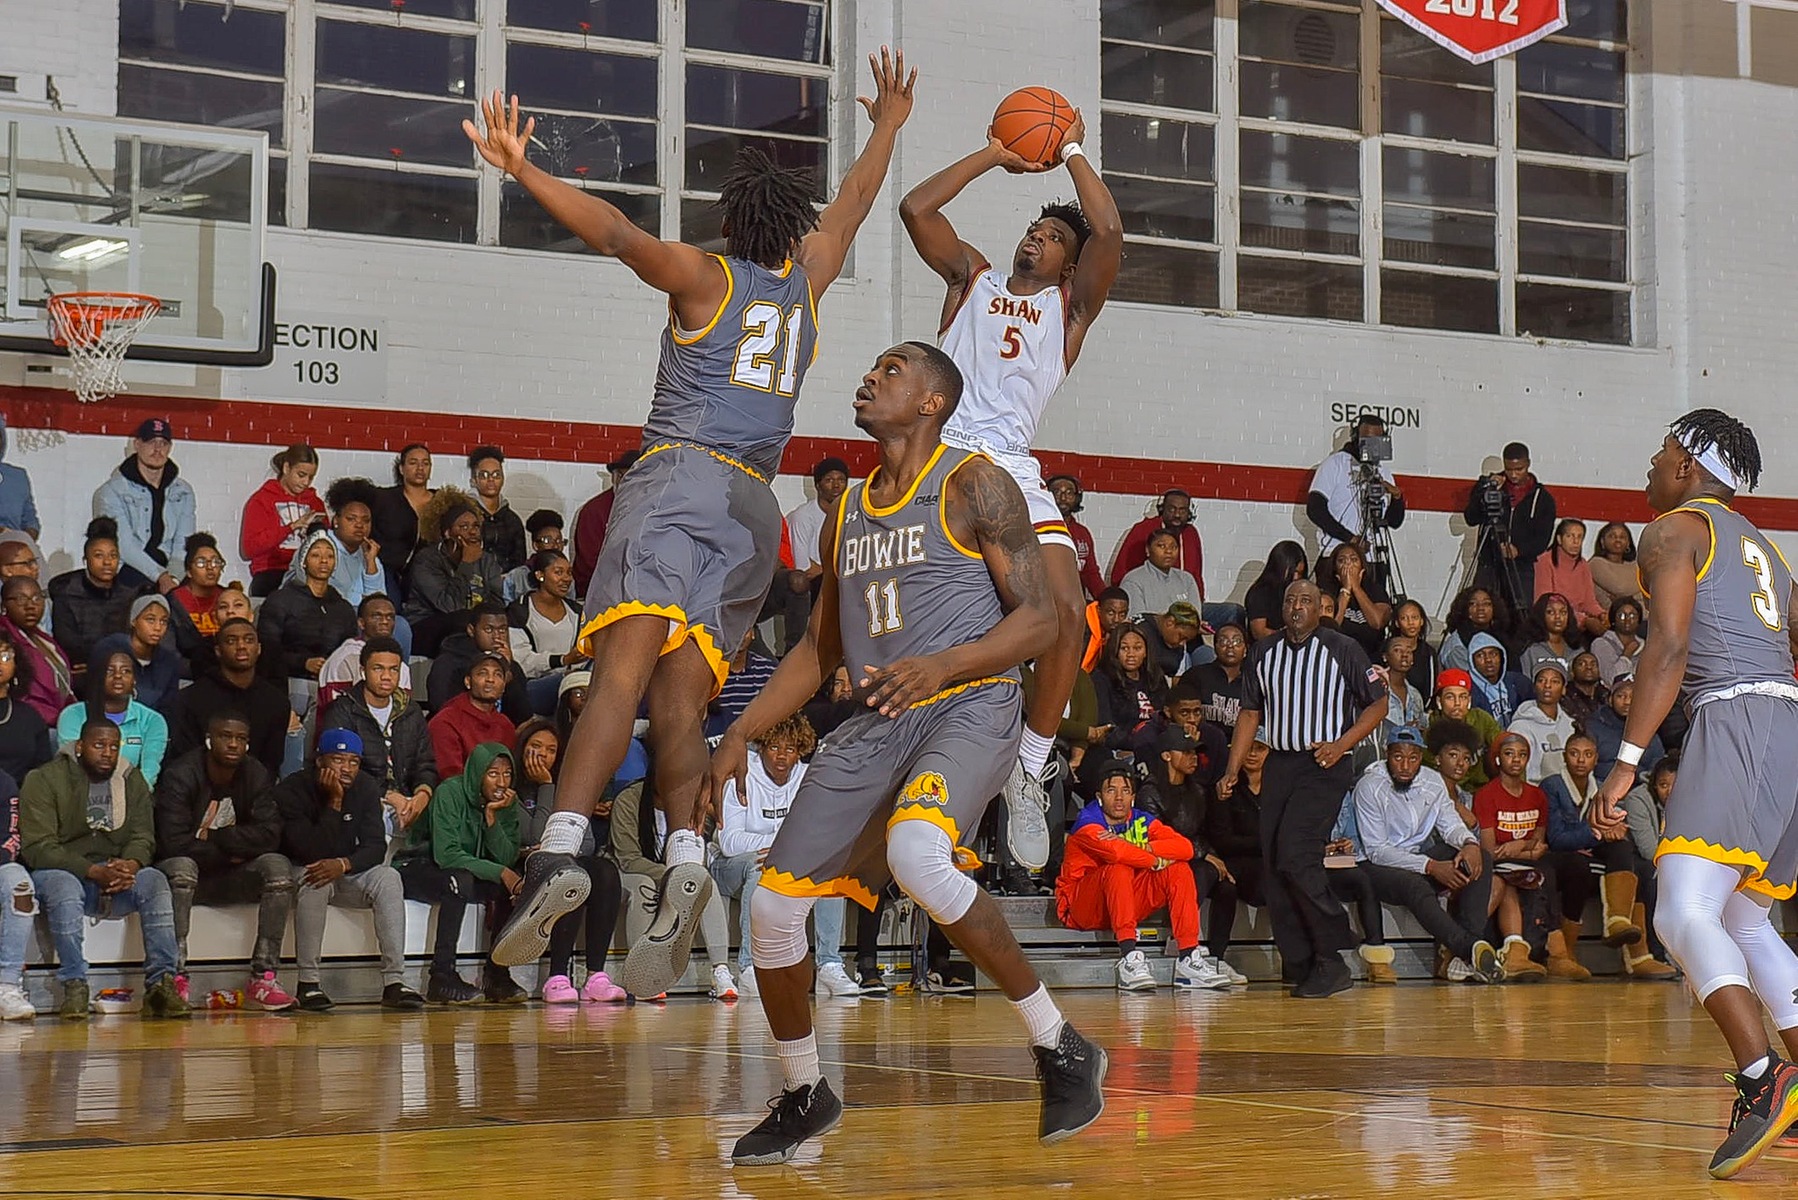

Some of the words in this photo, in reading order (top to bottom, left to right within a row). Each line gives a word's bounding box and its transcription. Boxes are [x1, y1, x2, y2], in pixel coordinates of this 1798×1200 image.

[274, 323, 378, 352] ECTION
[729, 300, 803, 398] 21
[999, 324, 1022, 360] 5
[293, 360, 339, 385] 103
[843, 523, 927, 578] BOWIE
[864, 577, 904, 638] 11
[1741, 535, 1781, 632] 3
